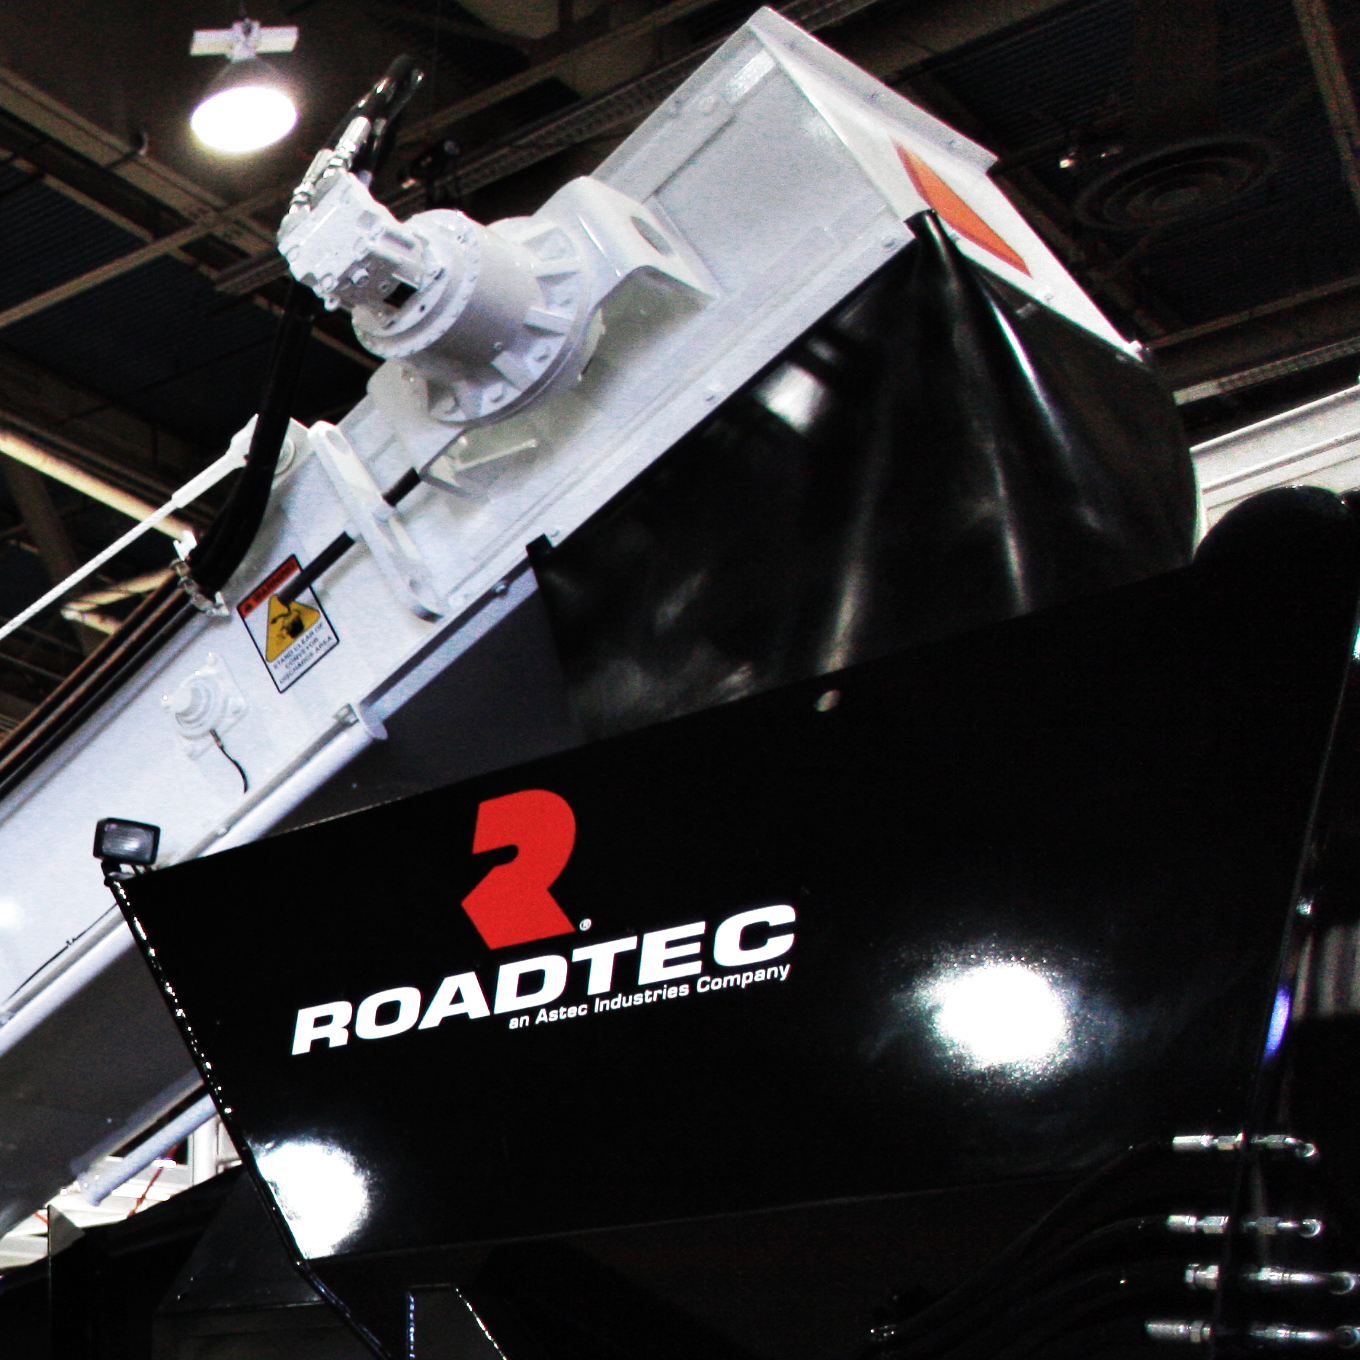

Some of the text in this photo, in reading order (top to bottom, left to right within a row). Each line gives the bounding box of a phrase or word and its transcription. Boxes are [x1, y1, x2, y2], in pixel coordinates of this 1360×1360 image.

[291, 904, 797, 1056] ROADTEC
[508, 963, 791, 1030] an Astec Industries Company
